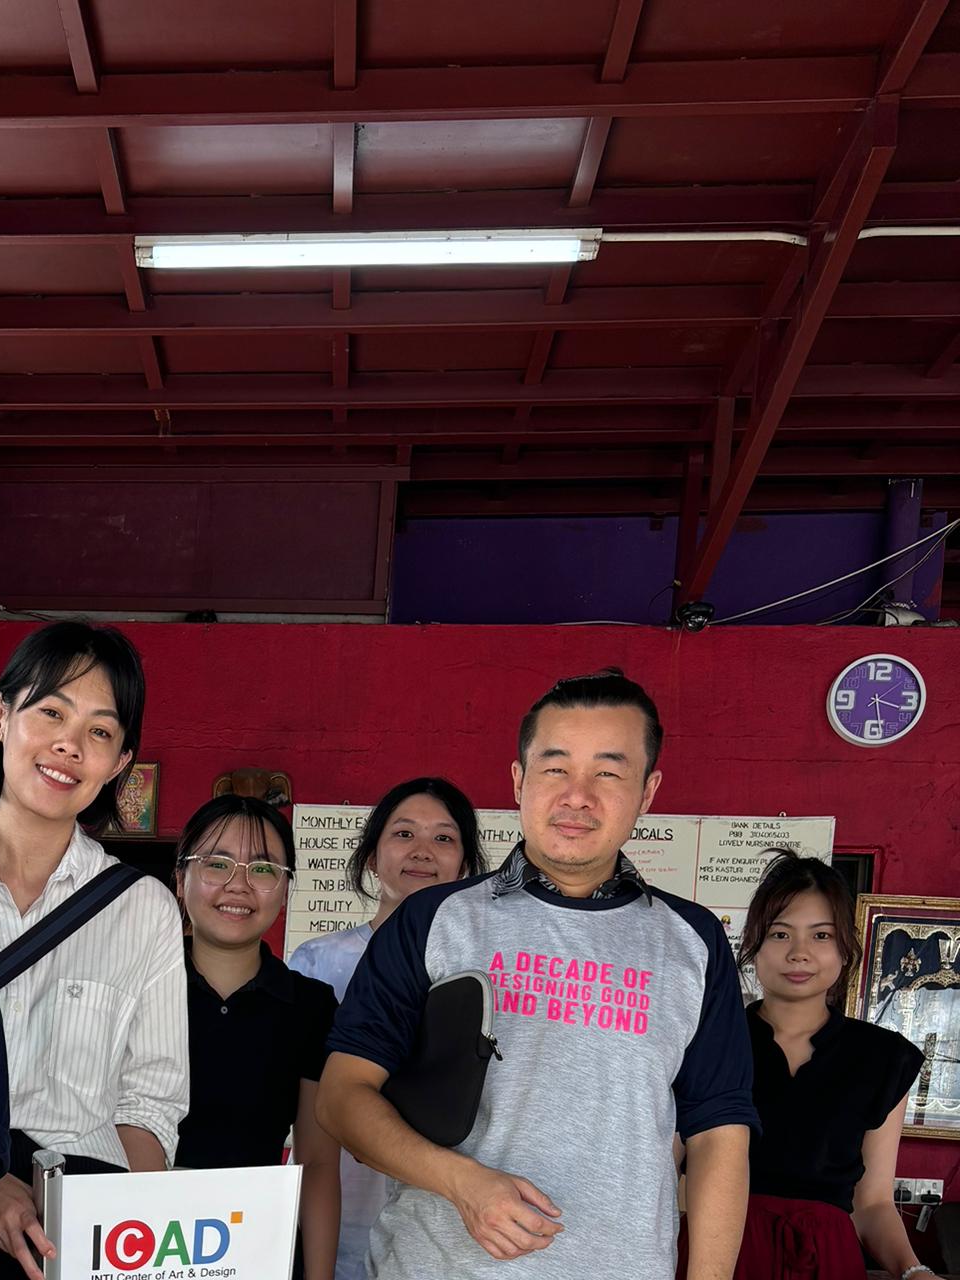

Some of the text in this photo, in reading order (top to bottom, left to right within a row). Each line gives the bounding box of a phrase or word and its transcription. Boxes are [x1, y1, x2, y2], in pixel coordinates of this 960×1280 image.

[867, 662, 893, 681] 12
[835, 690, 856, 710] 9
[900, 691, 919, 711] 3
[864, 720, 884, 739] 6
[301, 816, 353, 829] MONTHLY
[478, 829, 514, 841] NTHLY
[630, 828, 674, 840] DICALS
[300, 837, 339, 850] HOUSE
[308, 858, 346, 870] WATER
[716, 857, 730, 865] ANY
[312, 879, 334, 891] TNB
[307, 900, 352, 912] UTILITY
[489, 951, 653, 991] A DECADE OF
[489, 973, 650, 1011] DESIGNING GOOD
[547, 998, 649, 1035] BEYOND
[92, 1219, 231, 1271] ICAD
[155, 1270, 165, 1280] of
[168, 1270, 184, 1279] Art
[188, 1269, 196, 1278] &
[200, 1267, 236, 1279] Design
